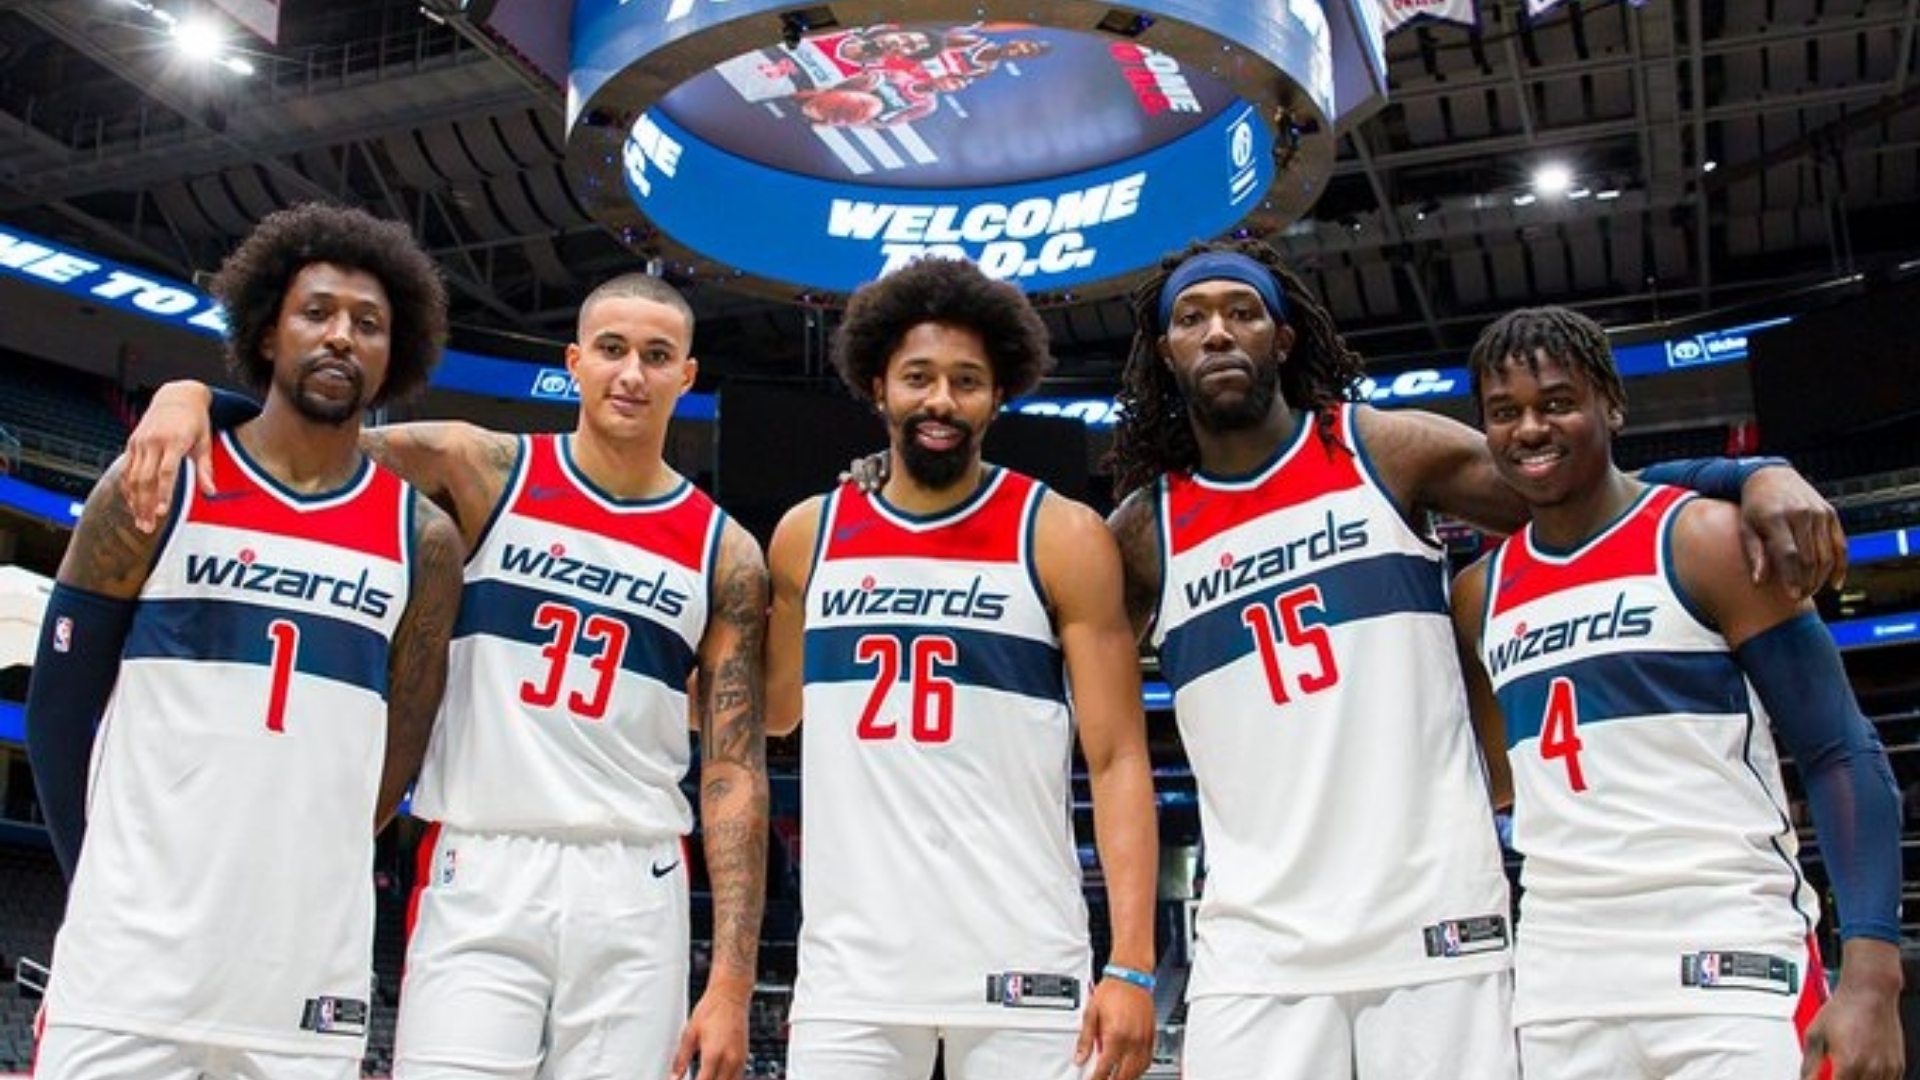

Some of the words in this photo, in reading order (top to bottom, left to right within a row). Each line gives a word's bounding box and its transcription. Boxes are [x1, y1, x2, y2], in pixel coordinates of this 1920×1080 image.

[827, 172, 1147, 243] WELCOME
[90, 269, 198, 314] TO
[978, 232, 1097, 281] D.C.
[186, 548, 394, 619] wizards
[500, 543, 689, 618] wizards
[821, 575, 1011, 621] wizards
[1184, 509, 1369, 609] wizards
[266, 620, 298, 734] 1
[519, 603, 629, 721] 33
[1243, 585, 1339, 706] 15
[1489, 591, 1658, 677] wizards
[856, 634, 958, 743] 26
[1540, 680, 1588, 792] 4
